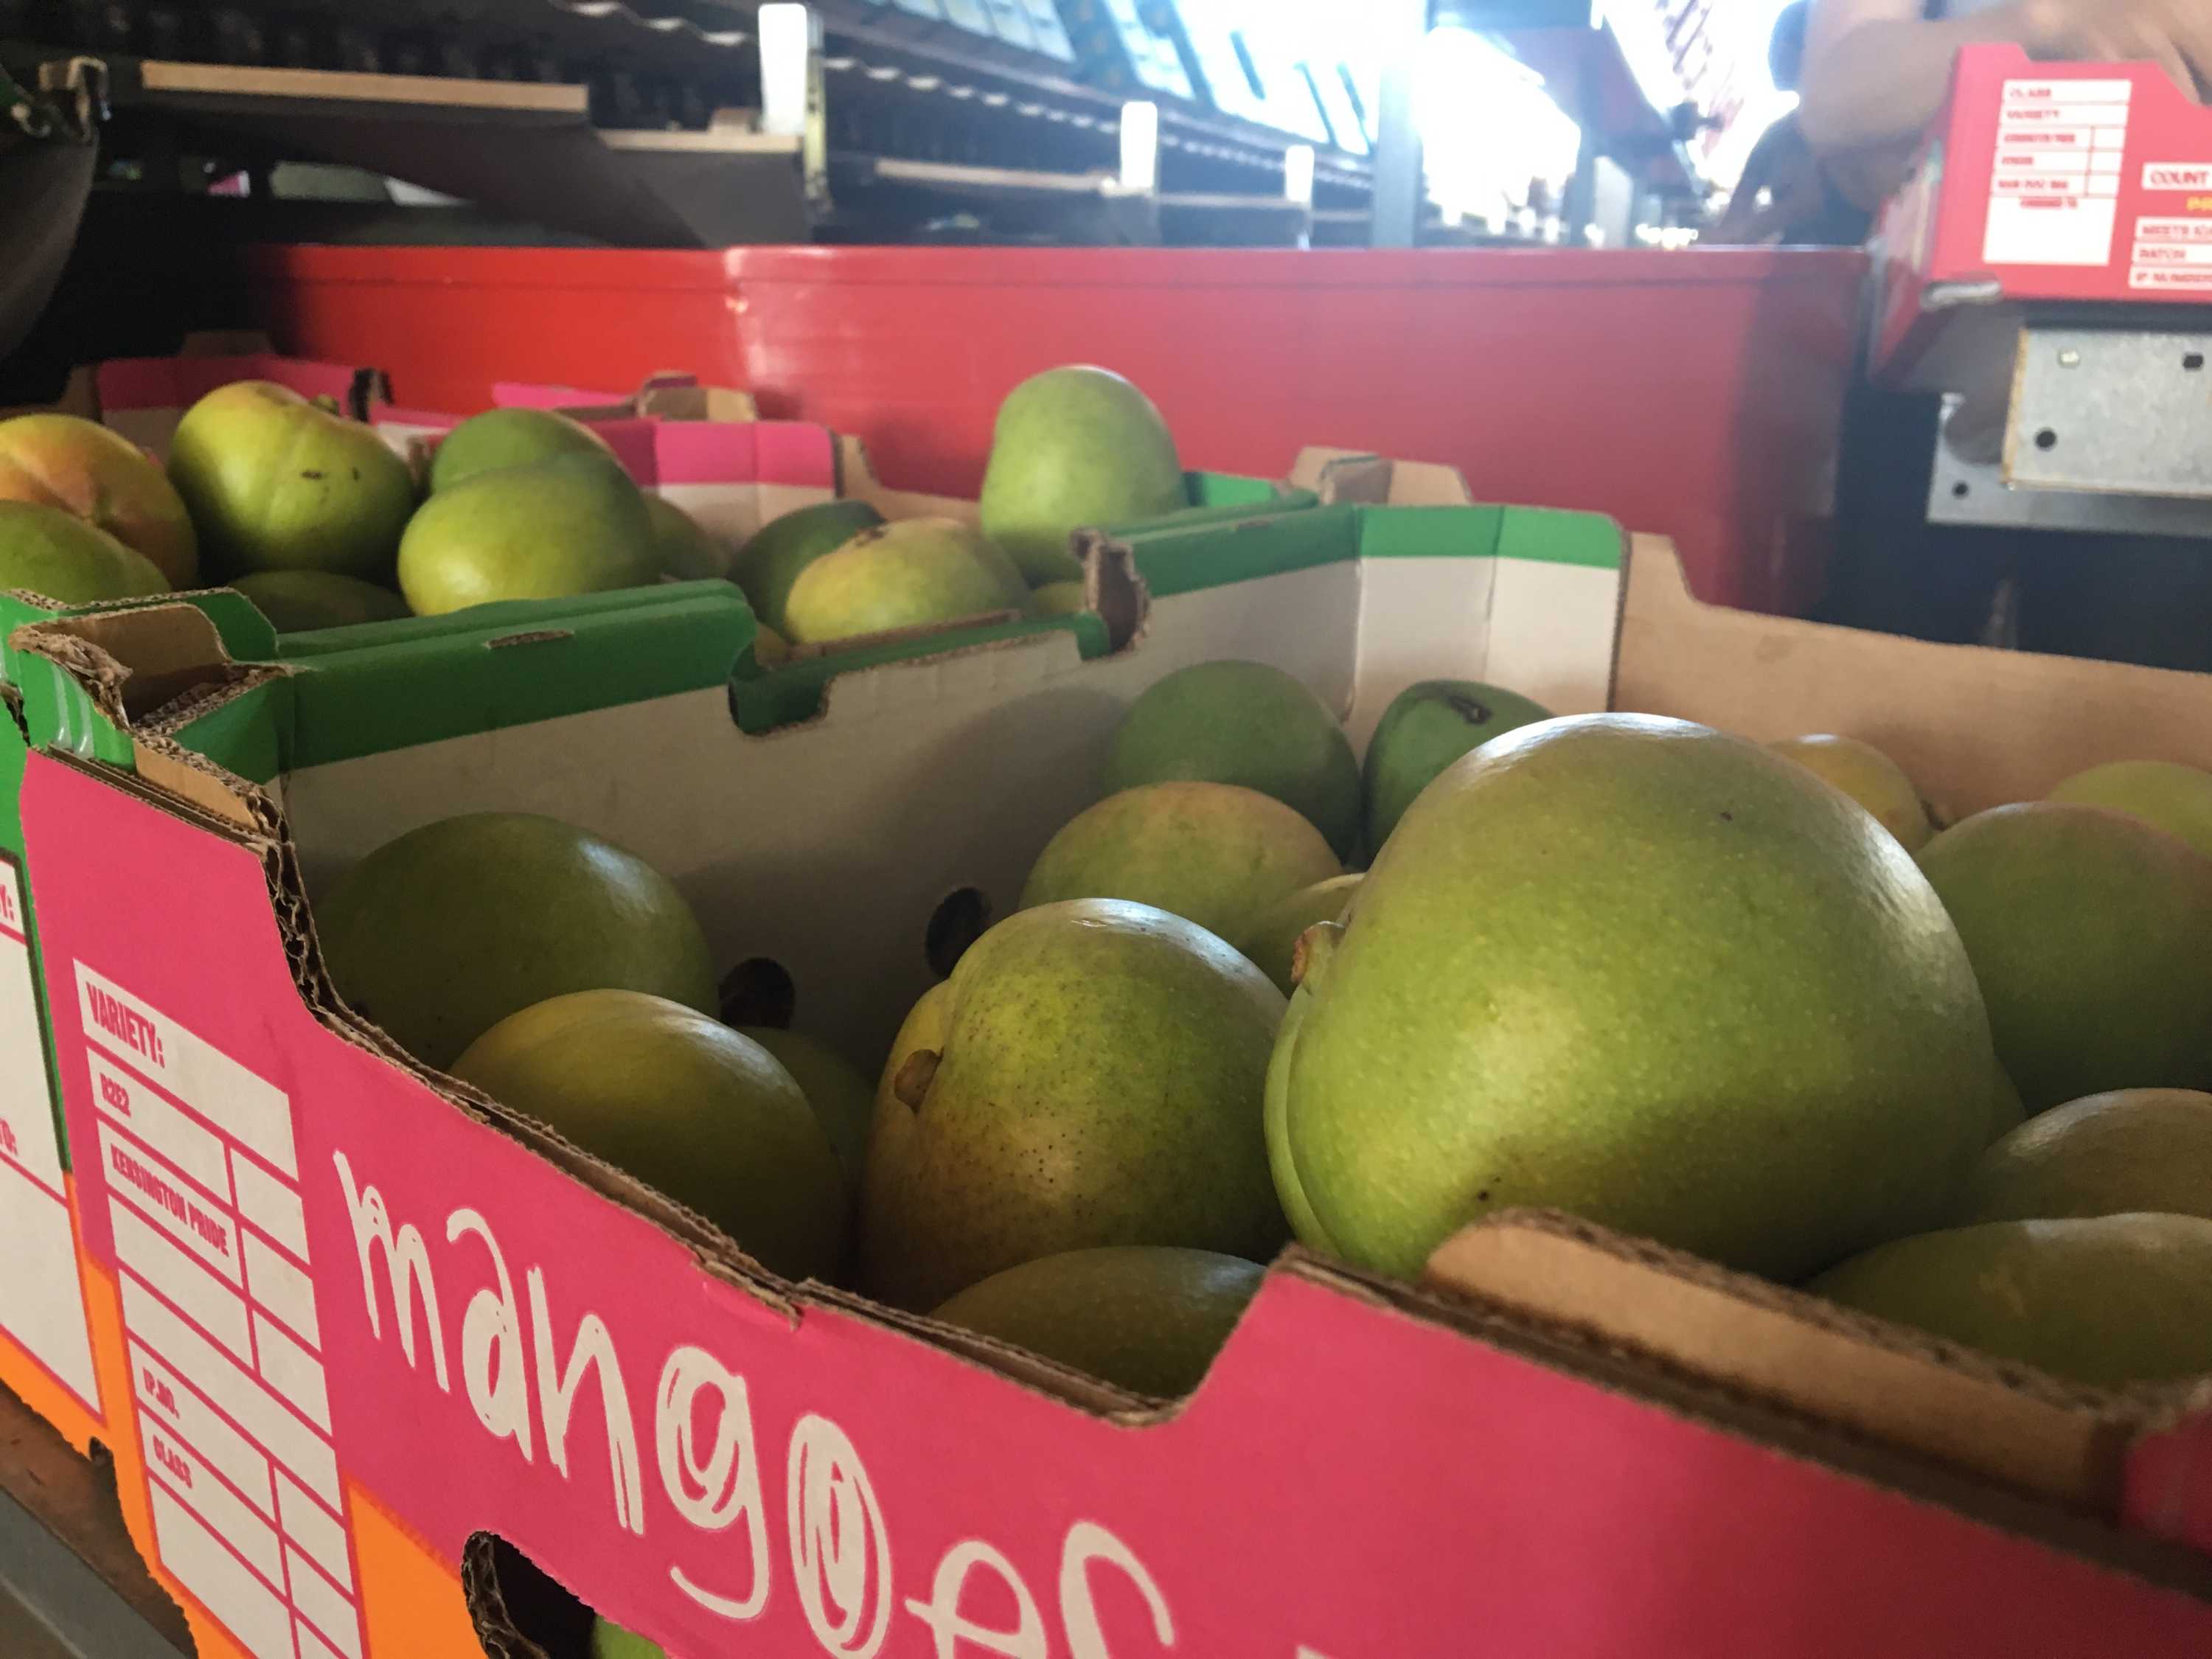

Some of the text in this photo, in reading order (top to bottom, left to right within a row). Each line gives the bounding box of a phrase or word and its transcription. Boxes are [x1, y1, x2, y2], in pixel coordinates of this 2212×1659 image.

[2149, 170, 2210, 185] COUNT
[85, 981, 165, 1068] VARIETY:
[111, 1143, 229, 1258] KENSINGTON PRIDE
[153, 1433, 192, 1489] CLASS
